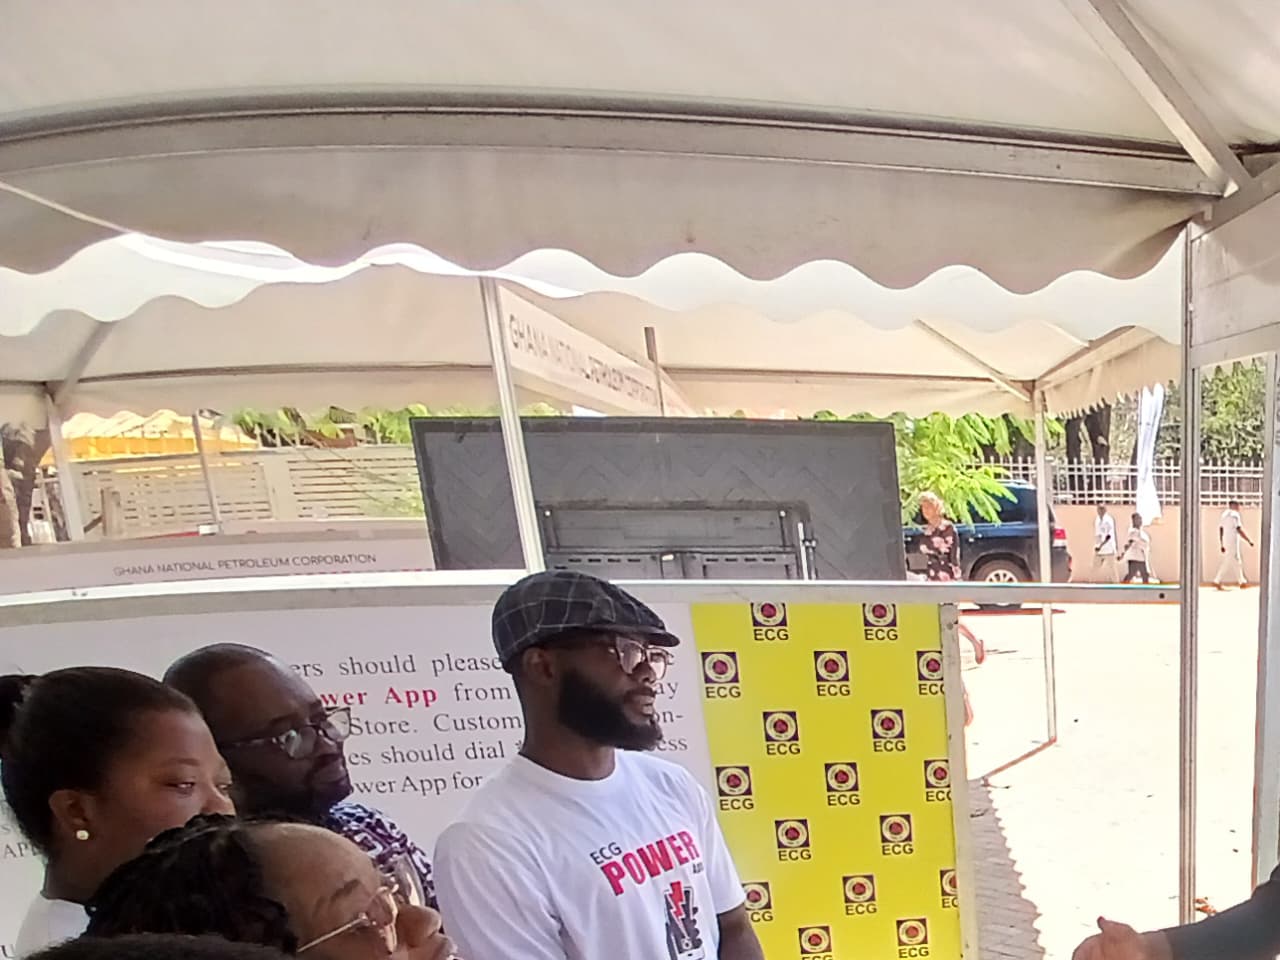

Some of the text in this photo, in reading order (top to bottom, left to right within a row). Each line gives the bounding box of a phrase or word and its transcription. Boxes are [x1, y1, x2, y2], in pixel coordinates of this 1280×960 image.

[113, 553, 377, 577] GHANA NATIONAL PETROLEUM CORPORATION
[753, 628, 789, 641] ECG
[864, 628, 898, 641] ECG
[339, 654, 416, 677] should
[320, 689, 367, 706] wer
[385, 687, 438, 708] App
[454, 683, 512, 702] from
[705, 686, 741, 699] ECG
[816, 683, 850, 696] ECG
[350, 716, 418, 736] Store.
[433, 713, 522, 733] Custom
[381, 744, 455, 764] should
[465, 740, 505, 760] dial
[766, 743, 801, 755] ECG
[873, 740, 906, 752] ECG
[453, 771, 483, 790] for
[719, 799, 754, 811] ECG
[827, 793, 860, 806] ECG
[590, 841, 622, 865] ECG
[778, 848, 812, 861] ECG
[881, 843, 914, 855] ECG
[600, 830, 700, 896] POWER
[845, 903, 877, 915] ECG
[942, 897, 959, 908] EC
[750, 911, 774, 923] CG
[898, 947, 929, 958] ECG
